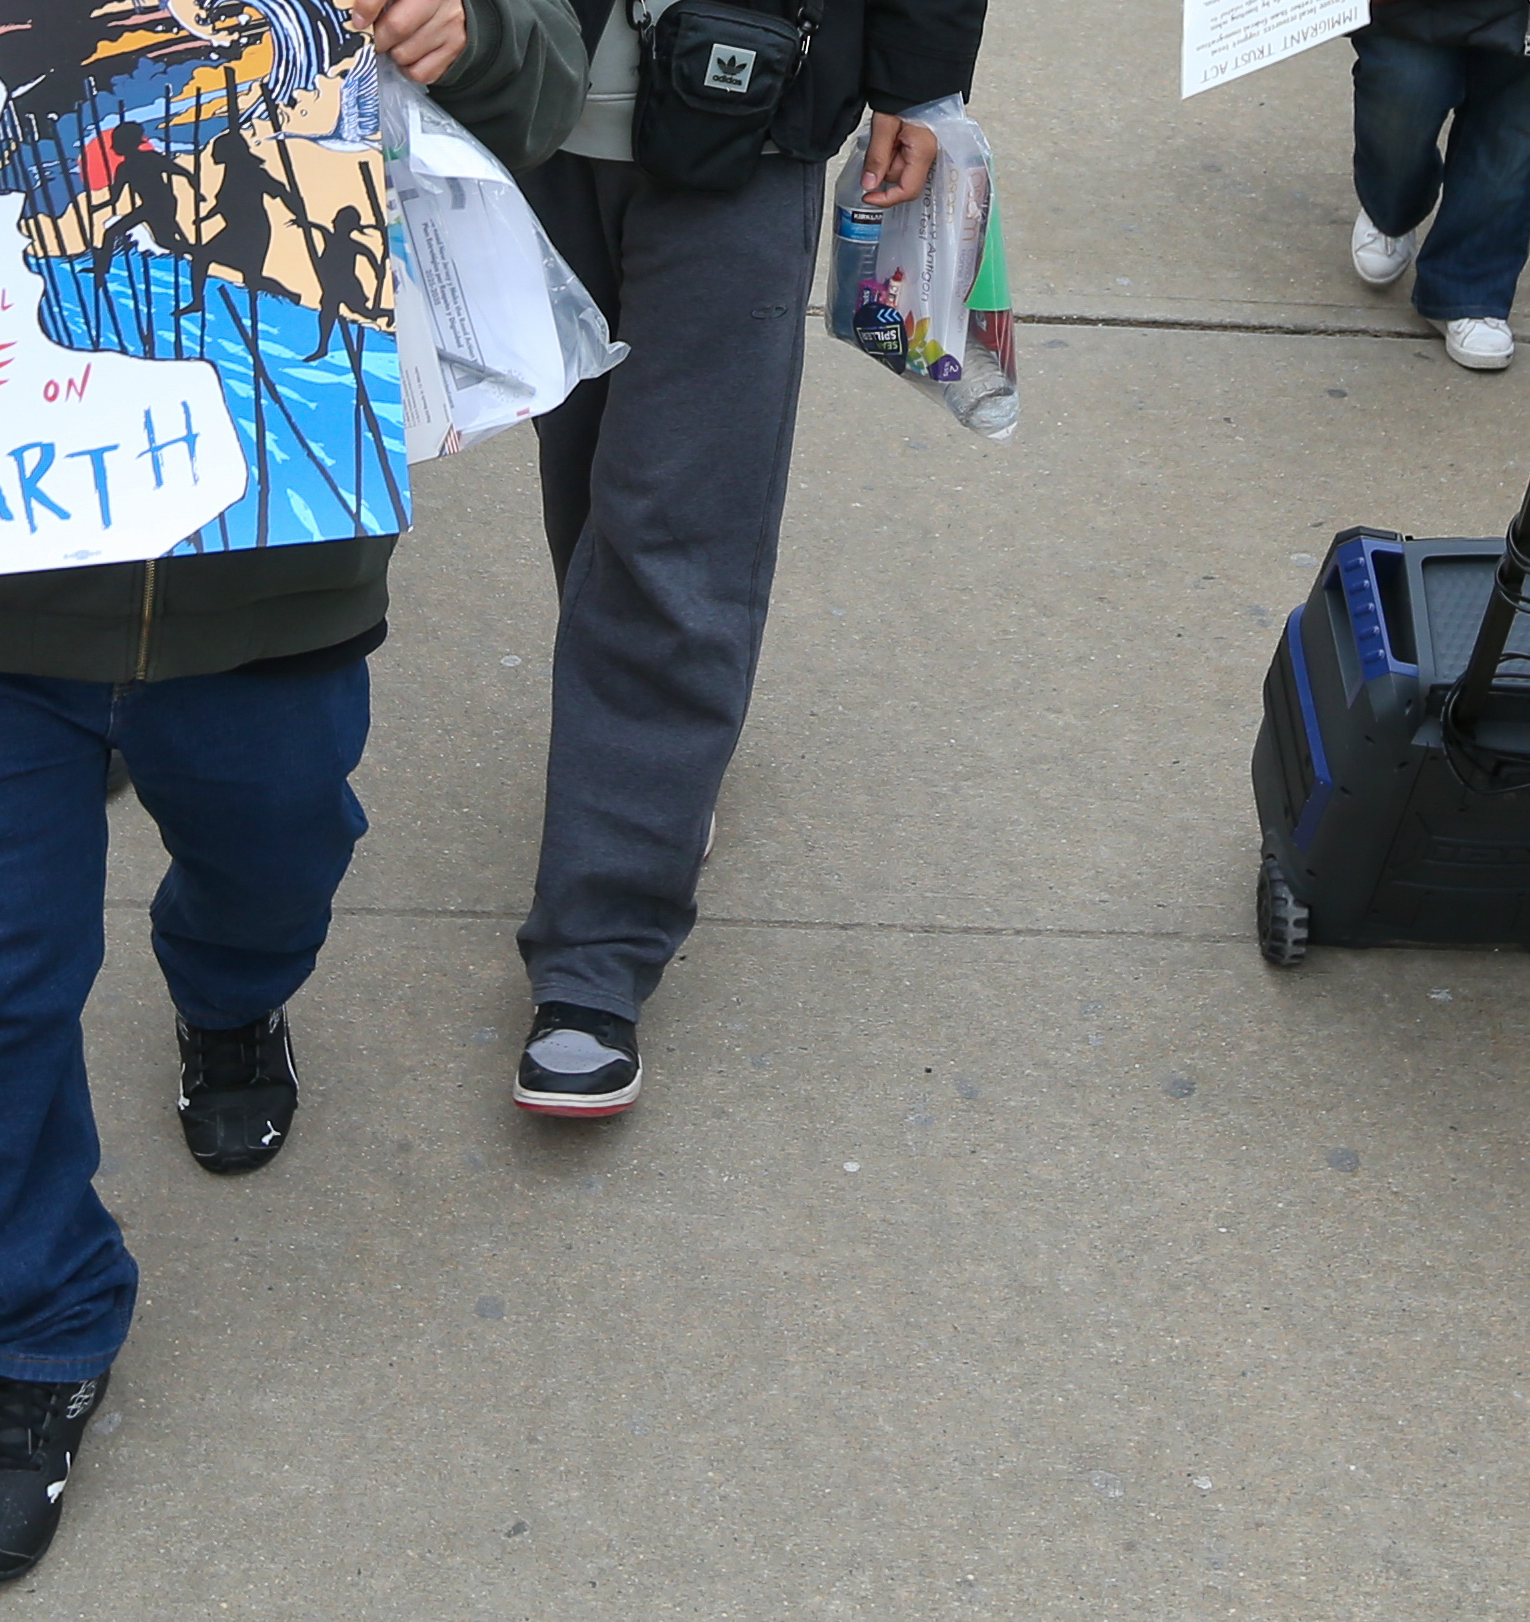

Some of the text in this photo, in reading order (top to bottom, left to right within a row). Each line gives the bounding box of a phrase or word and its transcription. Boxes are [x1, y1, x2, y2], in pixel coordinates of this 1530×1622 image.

[1200, 7, 1357, 83] IMMIGRANT TRUST ACT
[712, 74, 742, 86] adidas
[853, 210, 883, 221] KIRKLAN
[42, 362, 93, 403] ON
